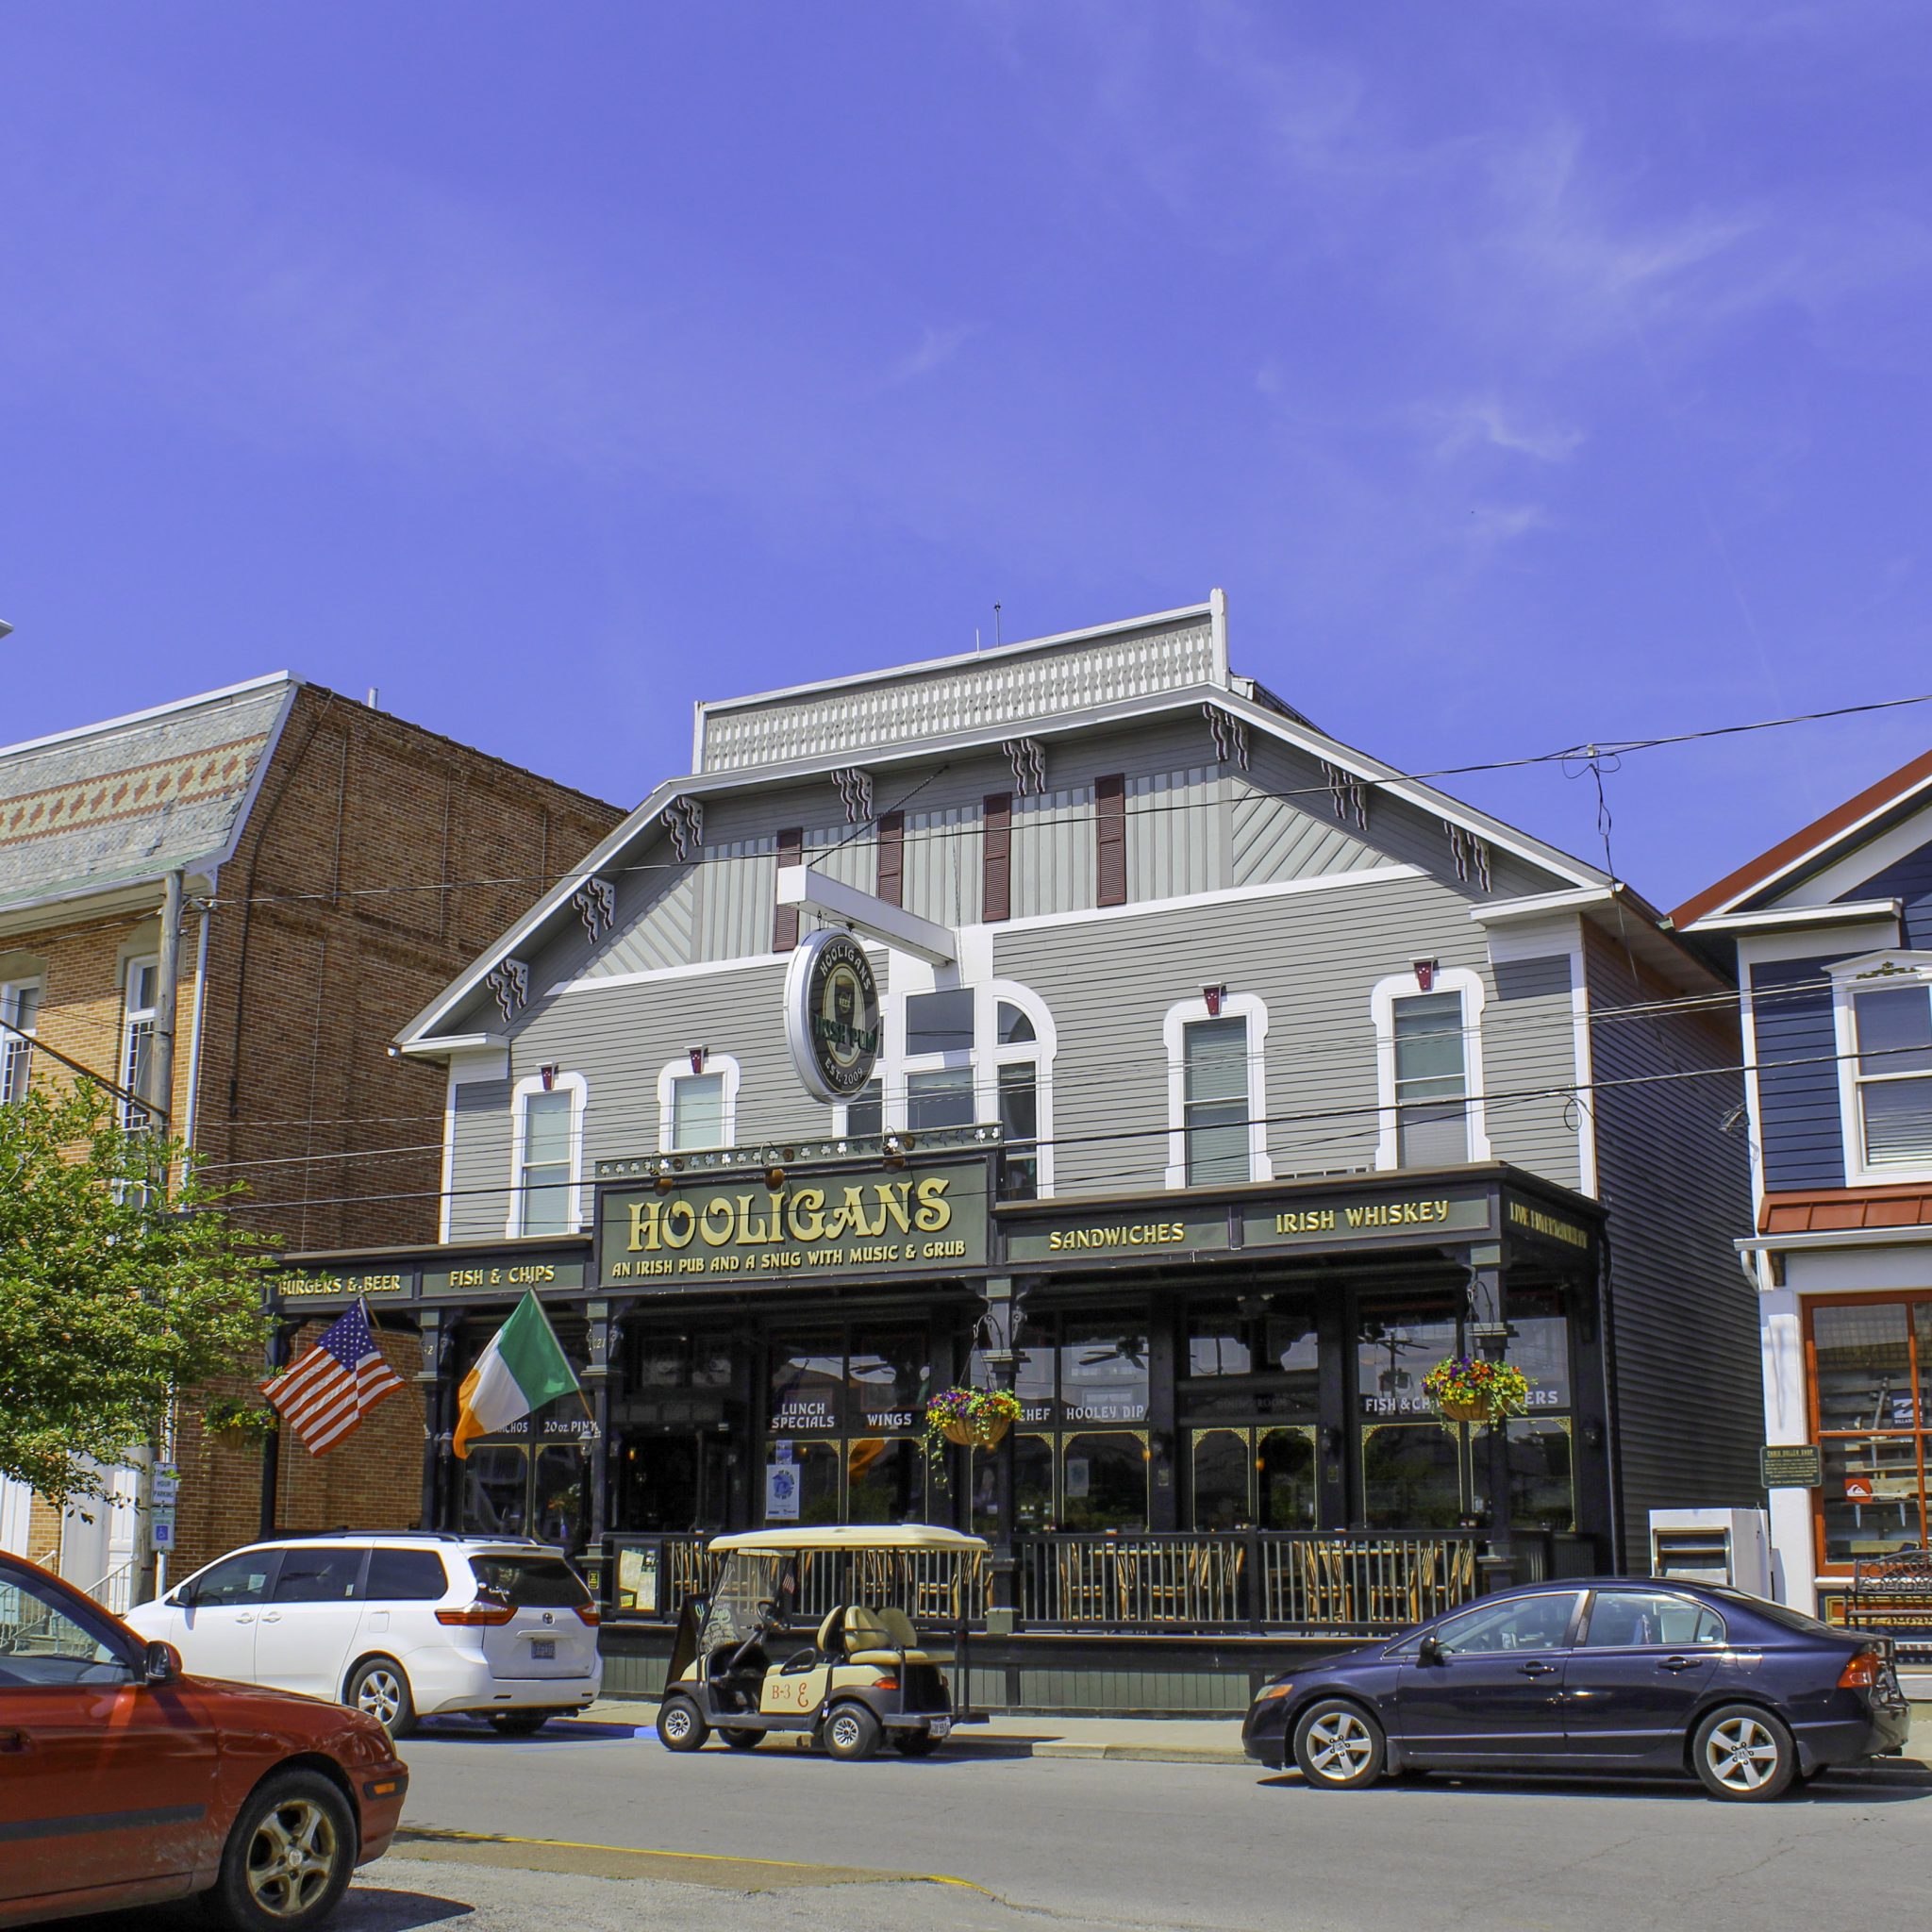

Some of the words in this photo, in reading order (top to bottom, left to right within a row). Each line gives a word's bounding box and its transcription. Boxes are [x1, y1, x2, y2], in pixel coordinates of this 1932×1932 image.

[820, 944, 871, 991] HOOLIGANS
[814, 1014, 846, 1044] IRISH
[850, 1027, 876, 1053] PUB
[824, 1058, 841, 1082] EST.
[843, 1067, 863, 1085] 2009
[627, 1177, 952, 1252] HOOLIGANS
[1275, 1208, 1335, 1235] IRISH
[1344, 1199, 1449, 1229] WHISKEY
[1049, 1222, 1185, 1251] SANDWICHES
[612, 1262, 630, 1277] AN
[637, 1259, 673, 1276] IRISH
[678, 1257, 705, 1273] PUB
[710, 1255, 740, 1272] AND
[745, 1254, 756, 1270] A
[761, 1252, 801, 1268] SNUG
[807, 1249, 843, 1265] WITH
[849, 1244, 898, 1262] MUSIC
[905, 1243, 916, 1259] &
[923, 1240, 966, 1257] GRUB
[278, 1276, 342, 1296] BURGERS
[347, 1276, 358, 1293] &
[364, 1274, 401, 1292] BEER
[450, 1269, 483, 1288] FISH
[491, 1268, 502, 1285] &
[508, 1264, 555, 1284] CHIPS
[781, 1403, 825, 1415] LUNCH
[1067, 1405, 1116, 1420] HOOLEY
[1123, 1405, 1144, 1418] DIP
[1365, 1398, 1396, 1412] FISH
[1400, 1397, 1410, 1411] &
[497, 1422, 528, 1433] CHOS
[544, 1421, 557, 1433] 20
[772, 1416, 835, 1429] SPECIALS
[867, 1413, 912, 1426] WINGS
[772, 1684, 791, 1700] B-3
